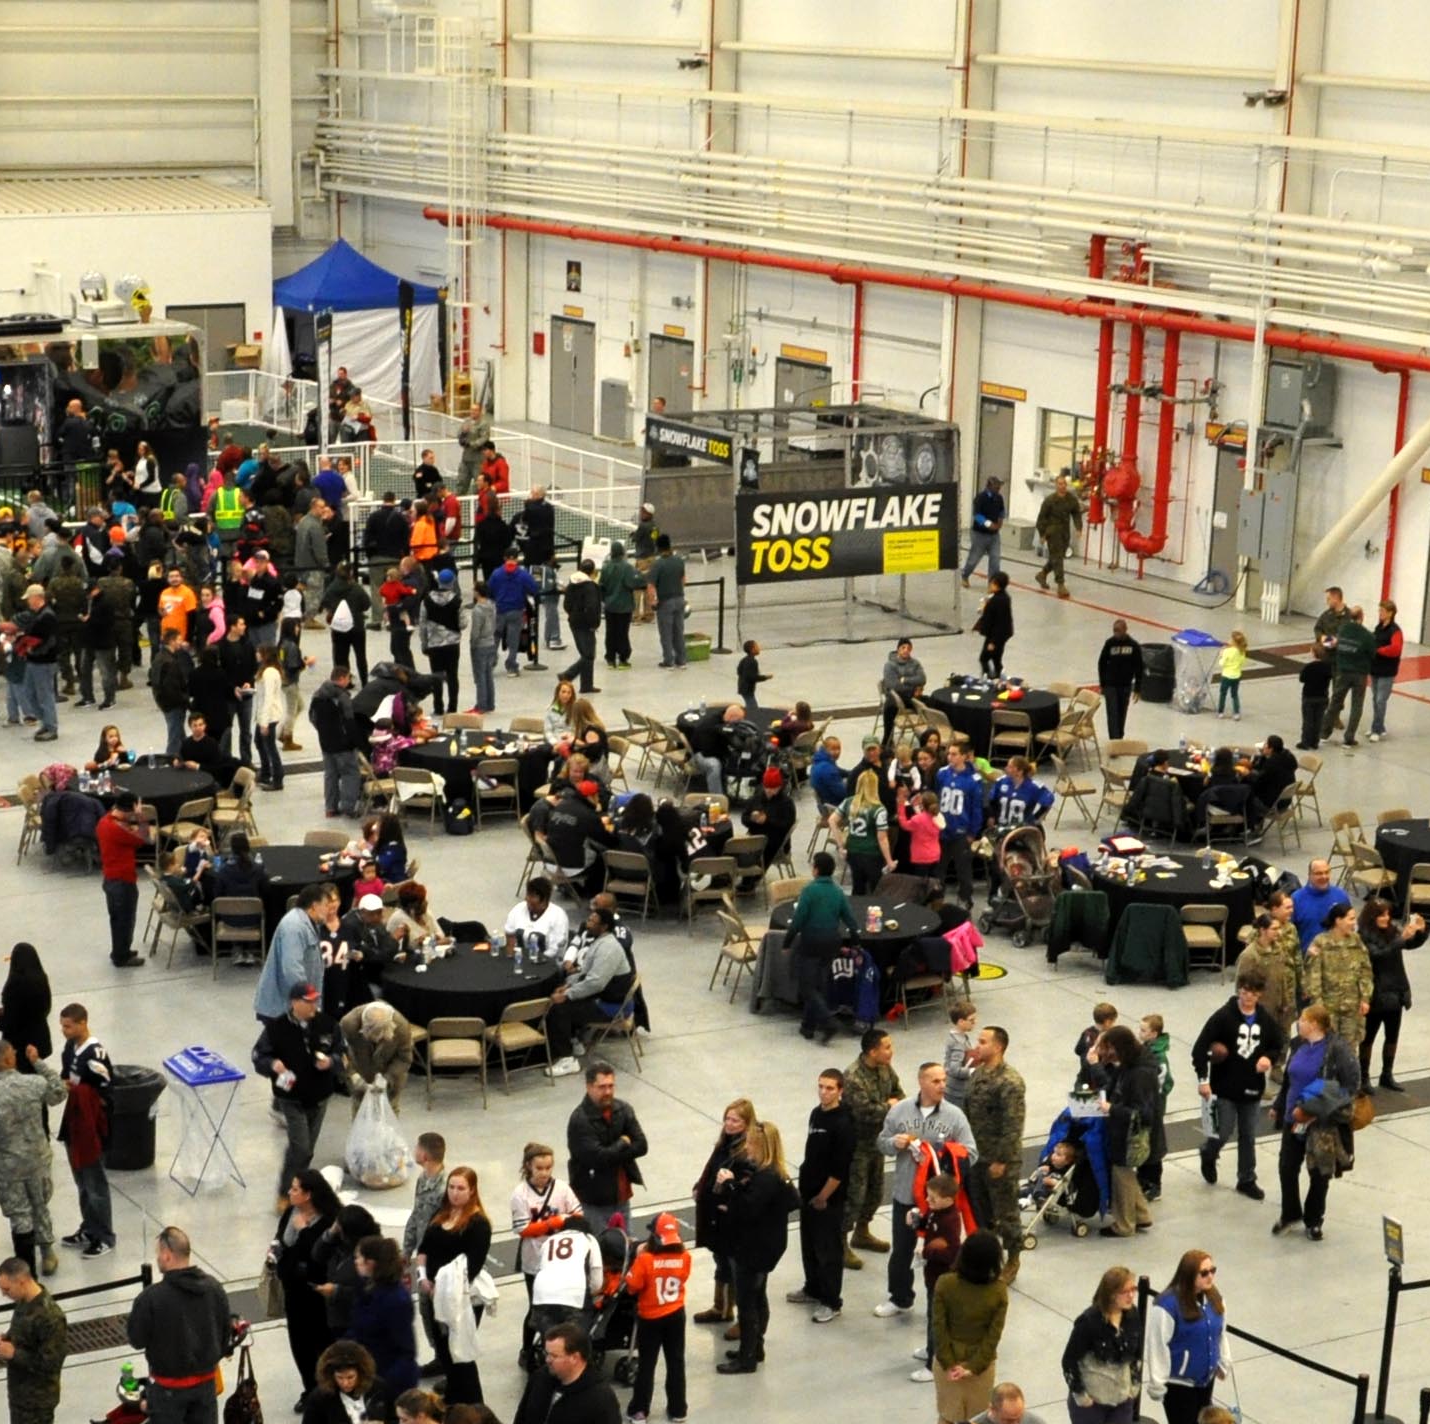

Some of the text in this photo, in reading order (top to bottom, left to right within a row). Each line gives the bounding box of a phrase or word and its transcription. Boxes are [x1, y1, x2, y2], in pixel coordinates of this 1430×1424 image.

[659, 428, 730, 458] SNOWFLAKE TOSS
[750, 493, 942, 538] SNOWFLAKE
[751, 536, 831, 574] TOSS
[547, 1237, 574, 1262] 18
